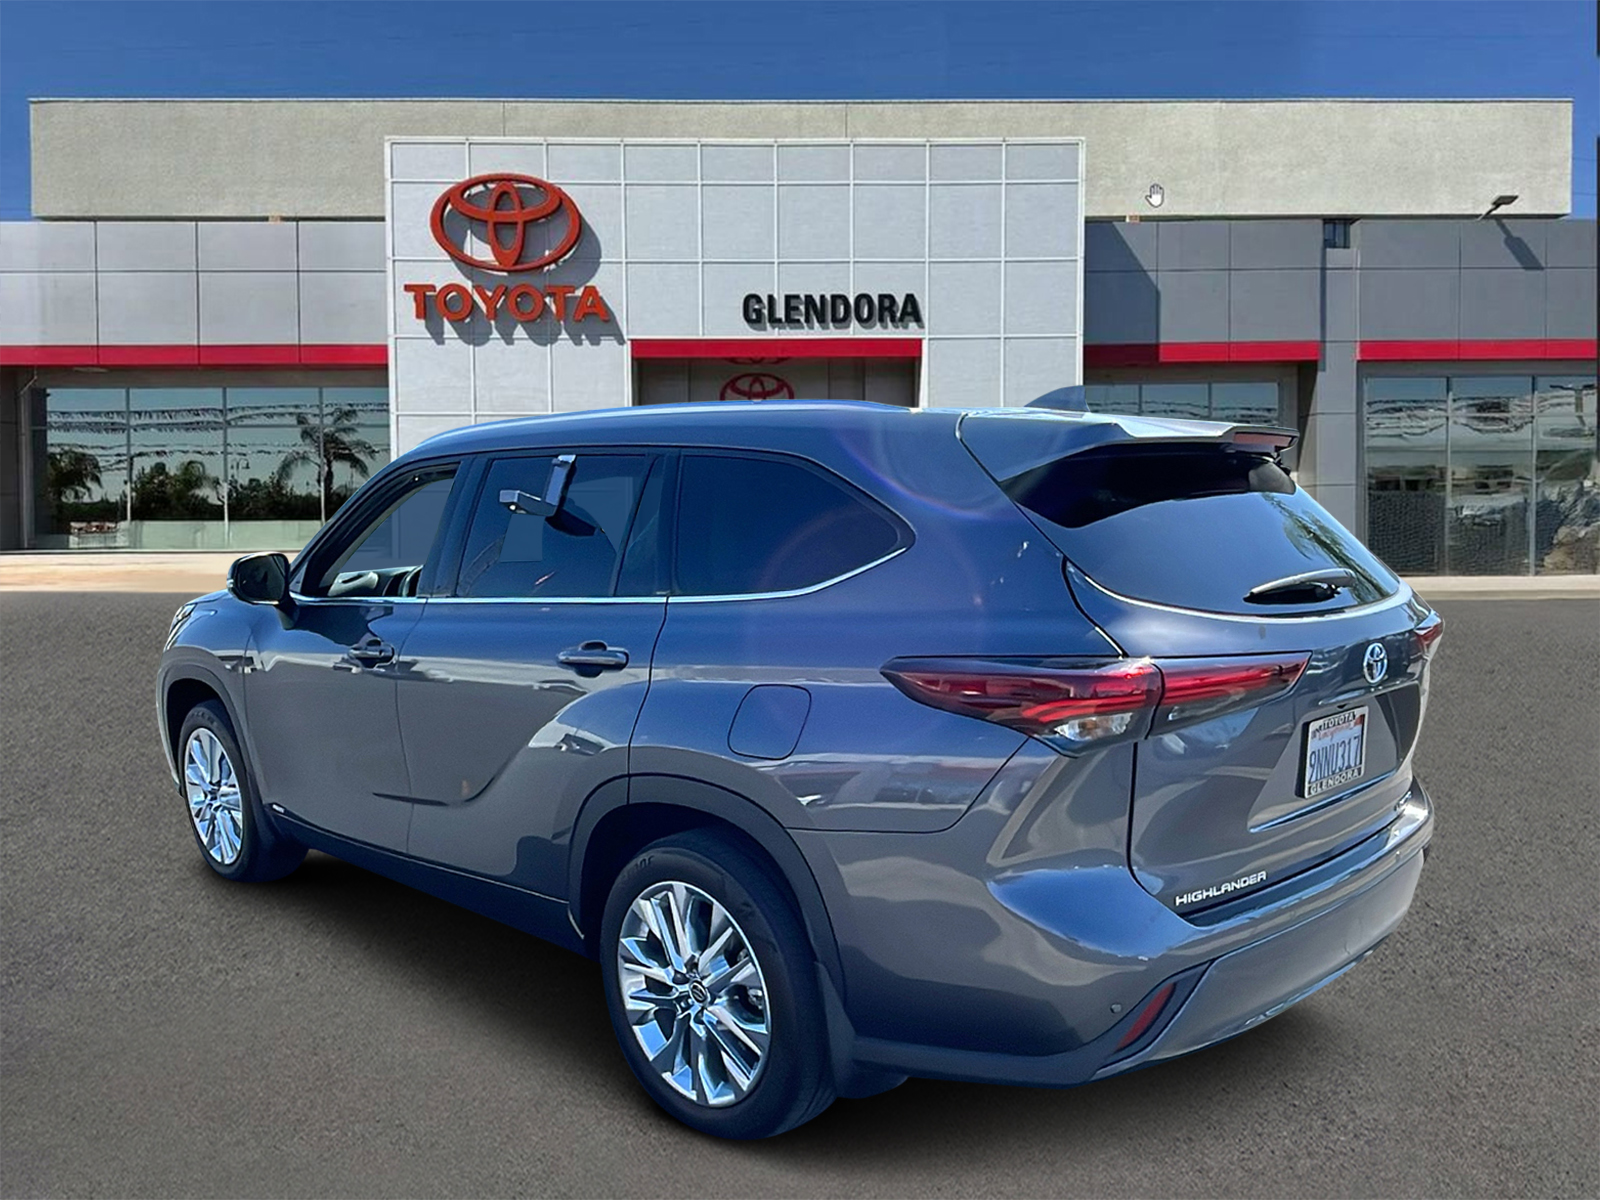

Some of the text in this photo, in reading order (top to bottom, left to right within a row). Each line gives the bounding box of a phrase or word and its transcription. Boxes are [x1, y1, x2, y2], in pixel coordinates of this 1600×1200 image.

[404, 283, 610, 322] TOYOTA
[742, 293, 922, 324] GLENDORA
[1323, 711, 1356, 730] TOYOTA
[1309, 736, 1361, 784] 9NNU317
[1310, 768, 1360, 794] GLENDORA
[1175, 870, 1267, 906] HIGHLANDER
